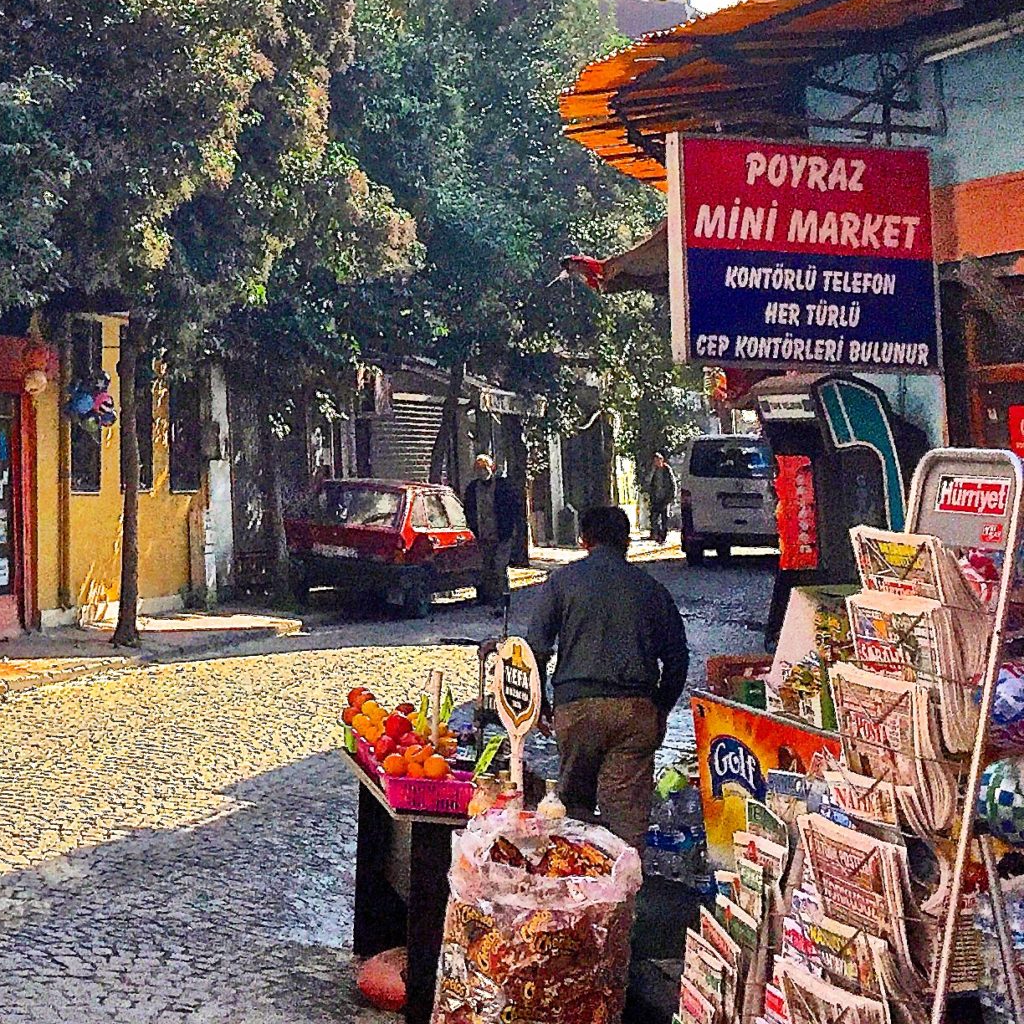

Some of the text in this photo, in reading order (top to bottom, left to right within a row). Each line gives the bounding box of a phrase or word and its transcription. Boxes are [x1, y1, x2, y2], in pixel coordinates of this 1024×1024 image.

[745, 152, 867, 192] POYRAZ
[693, 197, 921, 250] MİNİ MARKET
[725, 264, 896, 295] KONTÖRLÜ TELEFON
[765, 299, 860, 328] HER TÜRLÜ
[696, 333, 929, 367] CEP KONTÖRLERİ BULUNUR
[940, 479, 1007, 514] Hürriyet
[715, 742, 757, 791] Golf
